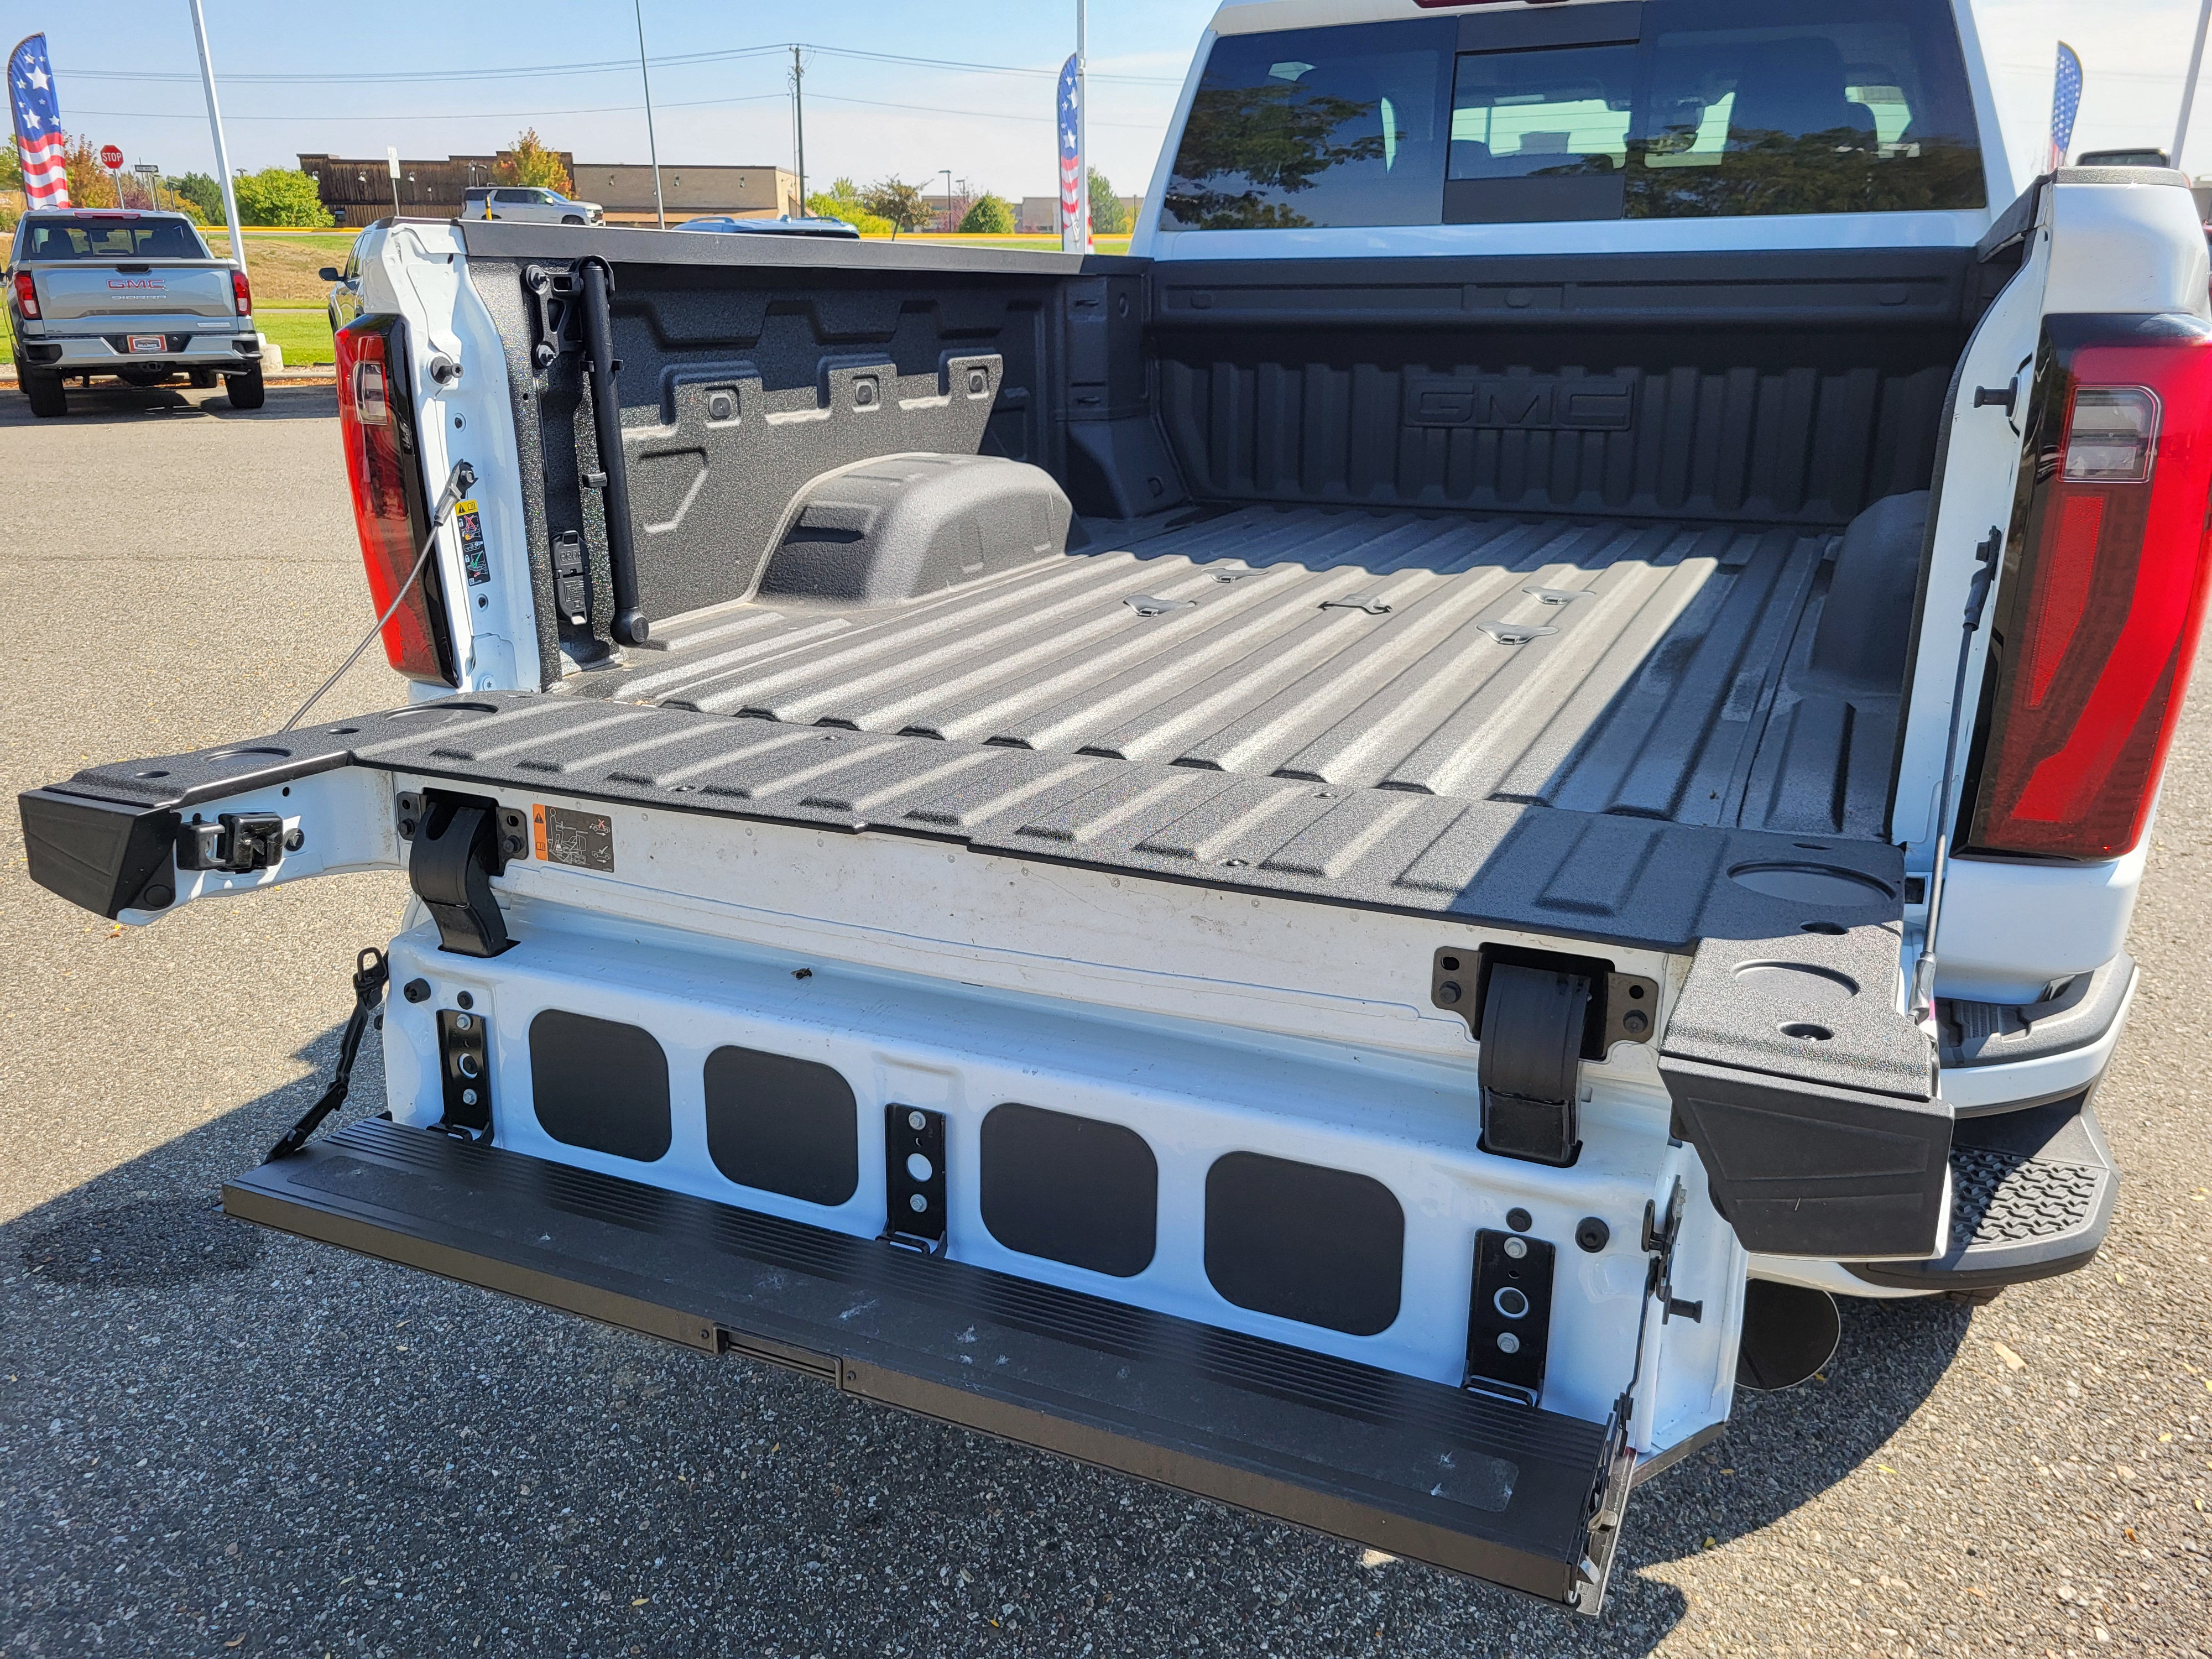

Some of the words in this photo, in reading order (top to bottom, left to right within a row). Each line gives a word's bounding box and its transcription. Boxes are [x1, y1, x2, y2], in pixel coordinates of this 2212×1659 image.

[102, 152, 121, 162] STOP
[107, 279, 165, 289] GMC
[1408, 380, 1630, 426] GMC
